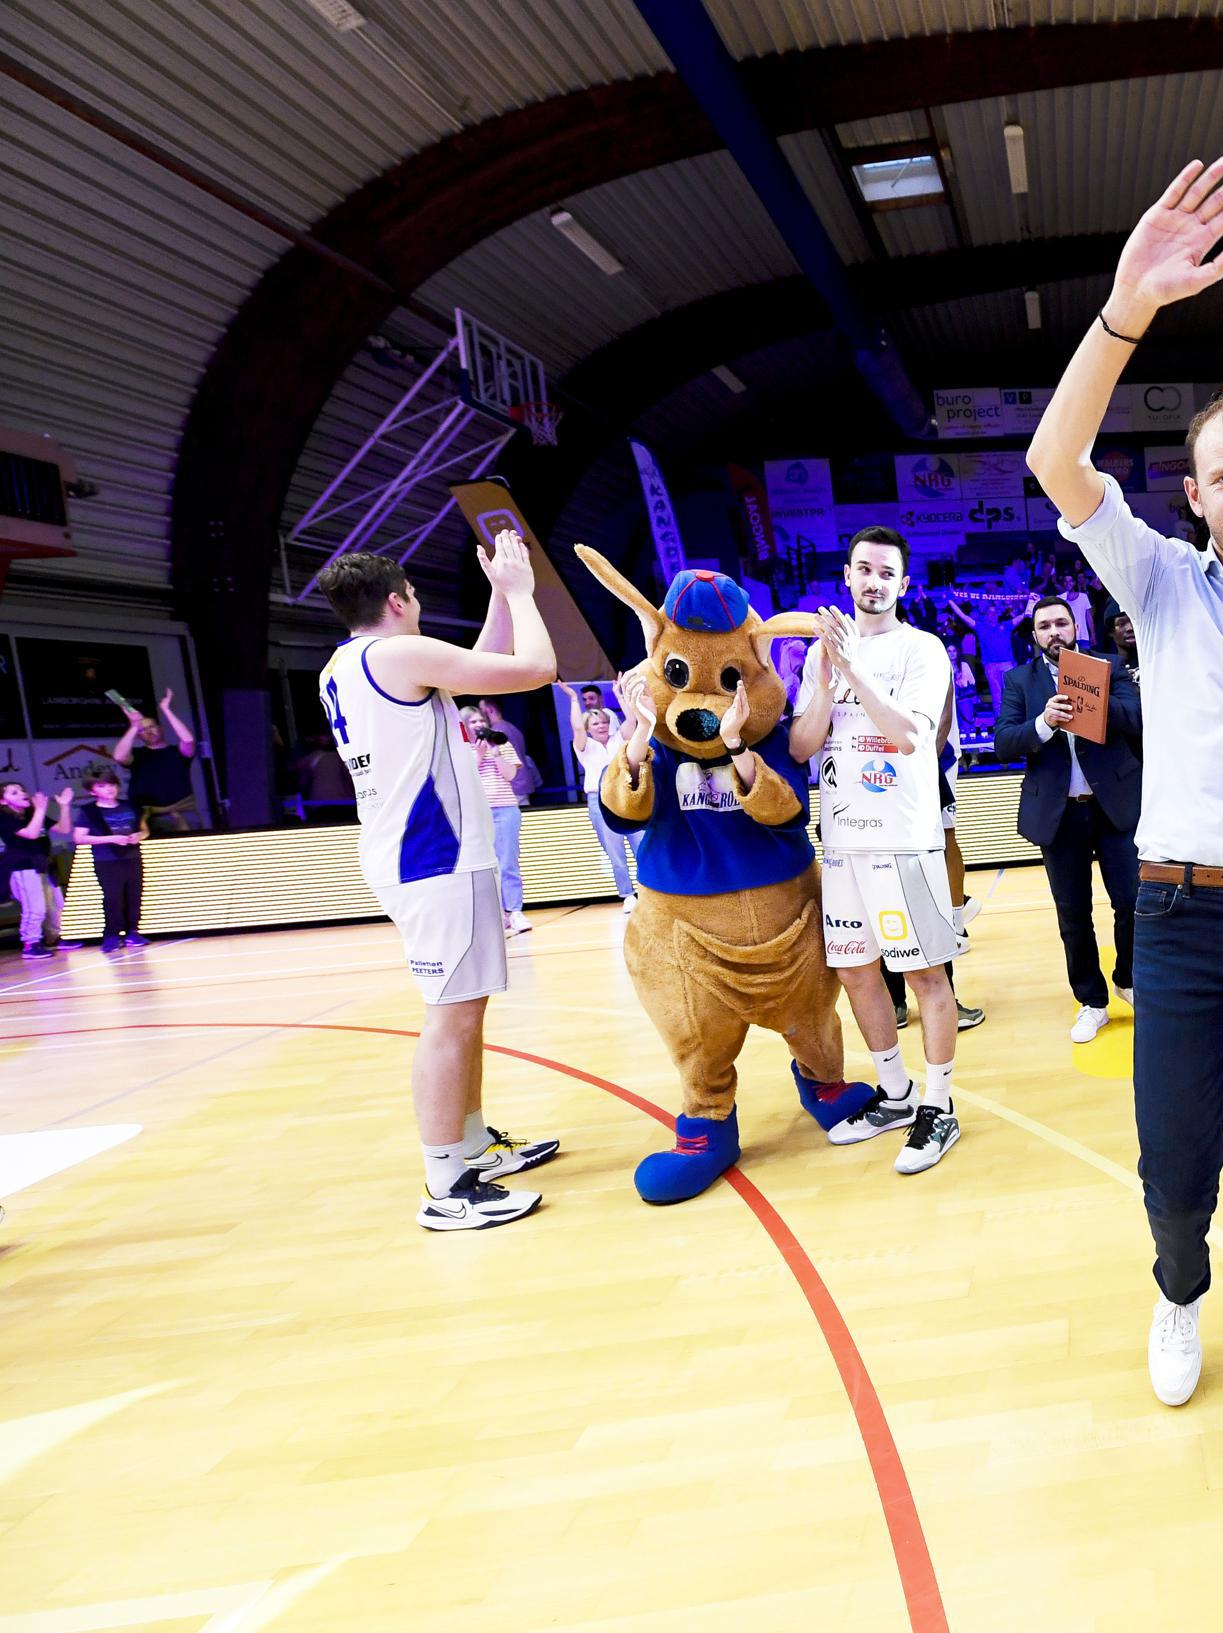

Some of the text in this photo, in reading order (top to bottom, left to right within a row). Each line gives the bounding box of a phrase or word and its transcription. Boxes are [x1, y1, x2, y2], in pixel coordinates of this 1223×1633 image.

[936, 392, 972, 406] buro
[946, 406, 1001, 422] project
[968, 501, 1015, 529] dps
[1063, 675, 1100, 698] SPALDING
[861, 773, 894, 785] NRG
[825, 914, 863, 929] Arco
